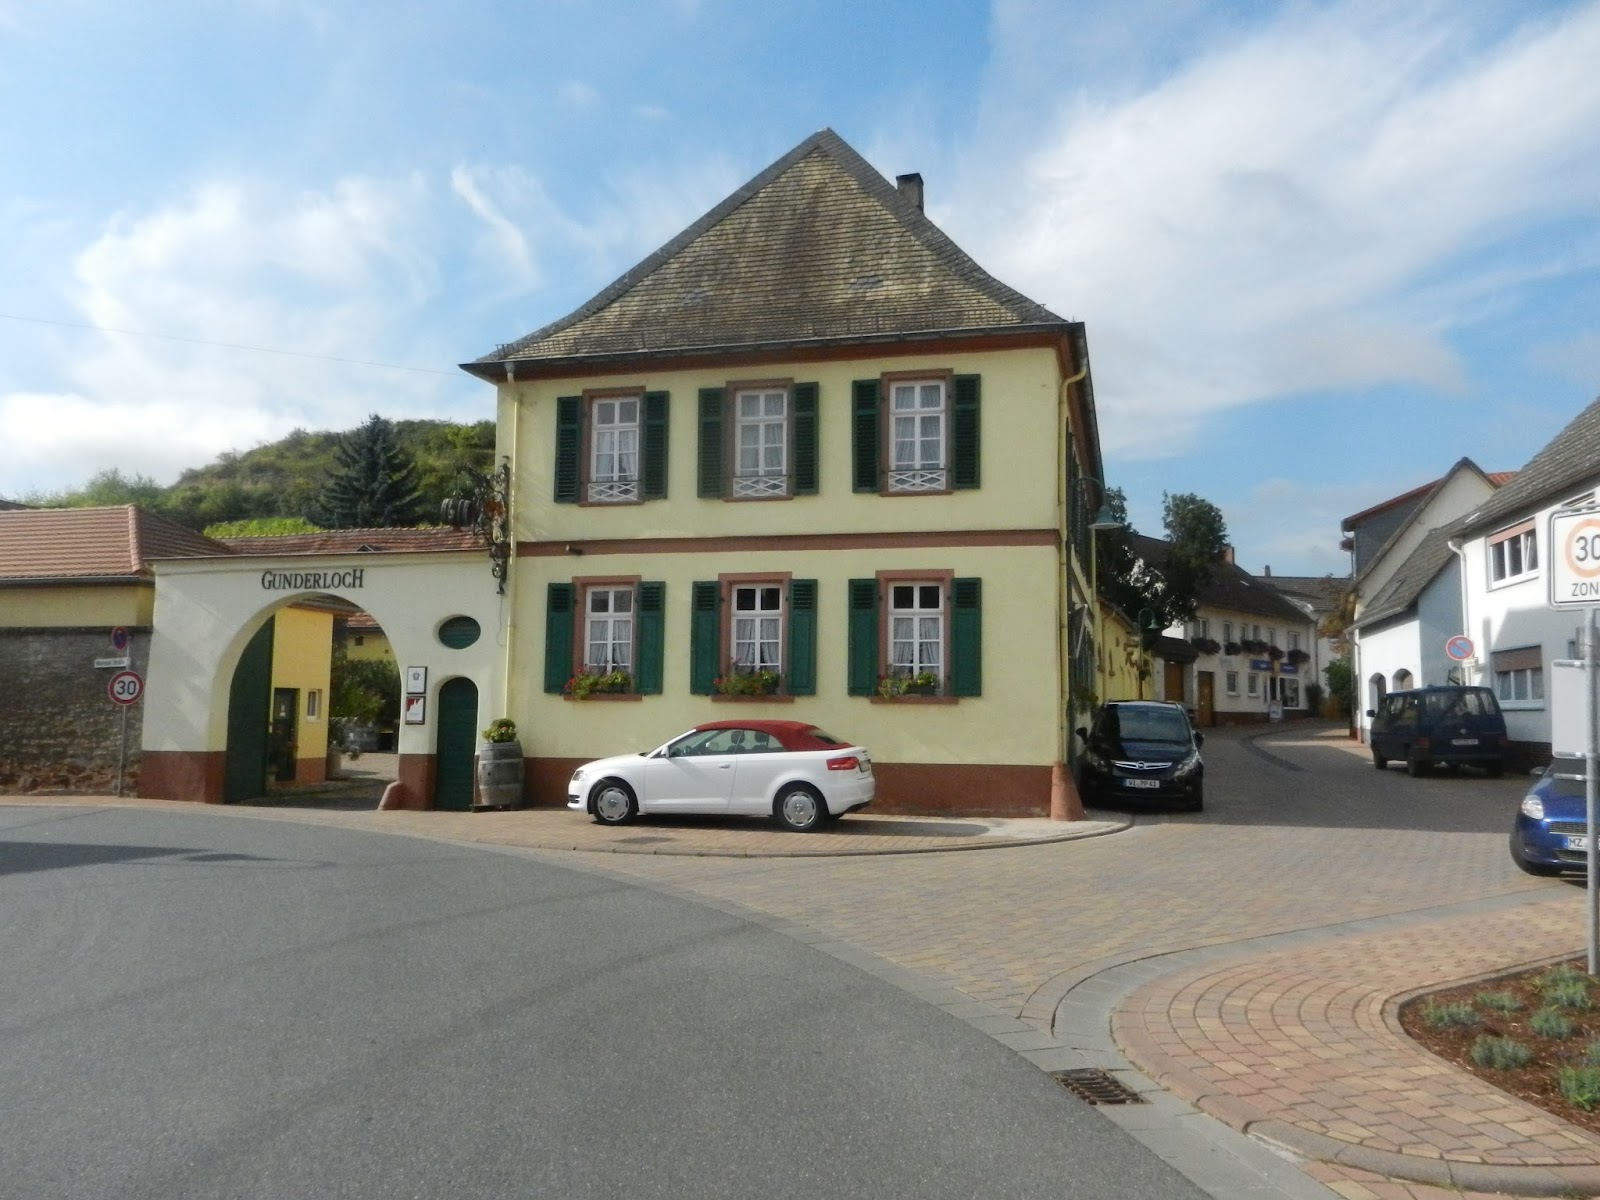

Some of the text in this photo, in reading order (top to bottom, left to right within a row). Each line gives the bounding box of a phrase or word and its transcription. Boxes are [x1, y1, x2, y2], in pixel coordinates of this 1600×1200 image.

[1575, 533, 1600, 562] 30
[261, 568, 364, 590] GUNDERLOCH
[116, 680, 137, 696] 30
[1568, 837, 1583, 848] MZ
